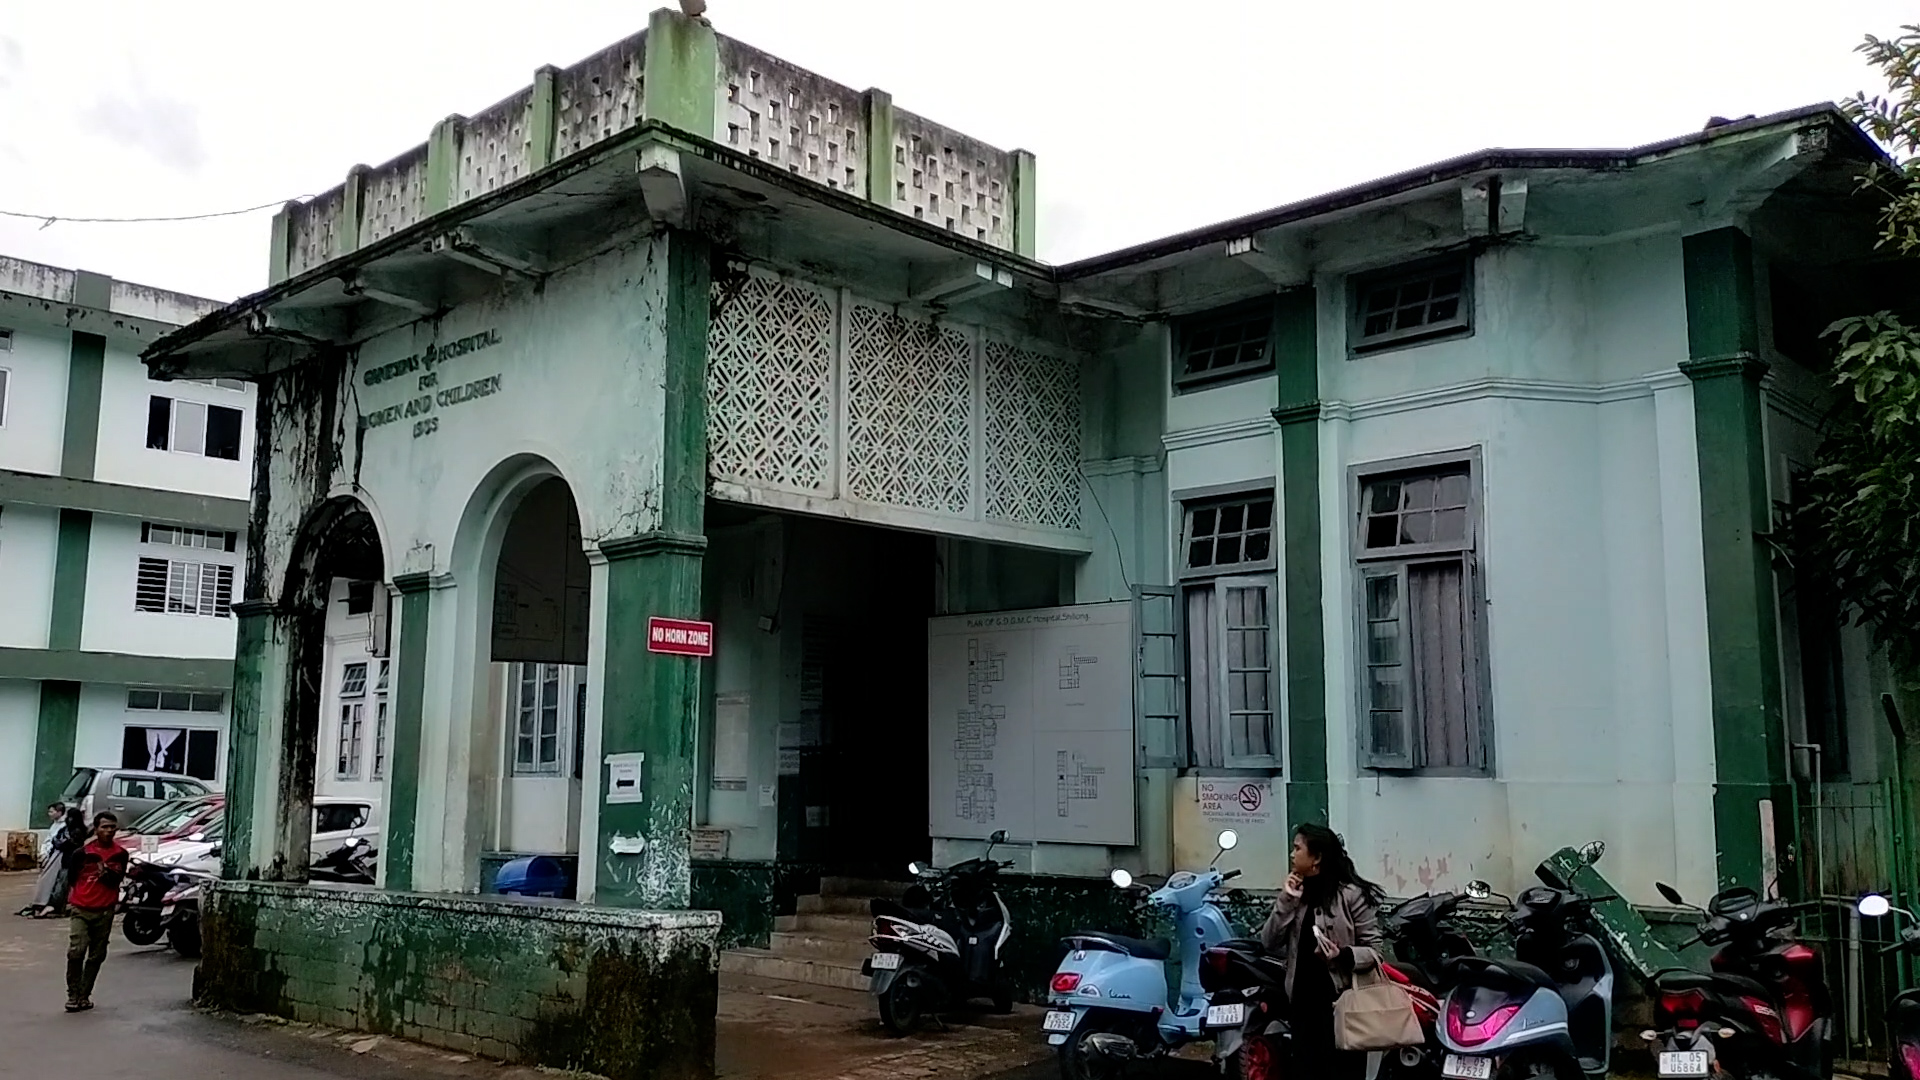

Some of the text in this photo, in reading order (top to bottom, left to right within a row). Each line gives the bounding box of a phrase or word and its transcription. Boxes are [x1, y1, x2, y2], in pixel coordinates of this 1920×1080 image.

[418, 372, 438, 391] FOR
[360, 373, 502, 430] OMEN AND CHILDREN
[652, 627, 708, 646] NO HORN ZONE
[1202, 793, 1238, 801] SMOKING
[1474, 1057, 1485, 1067] 05
[1671, 1052, 1701, 1063] ML 05
